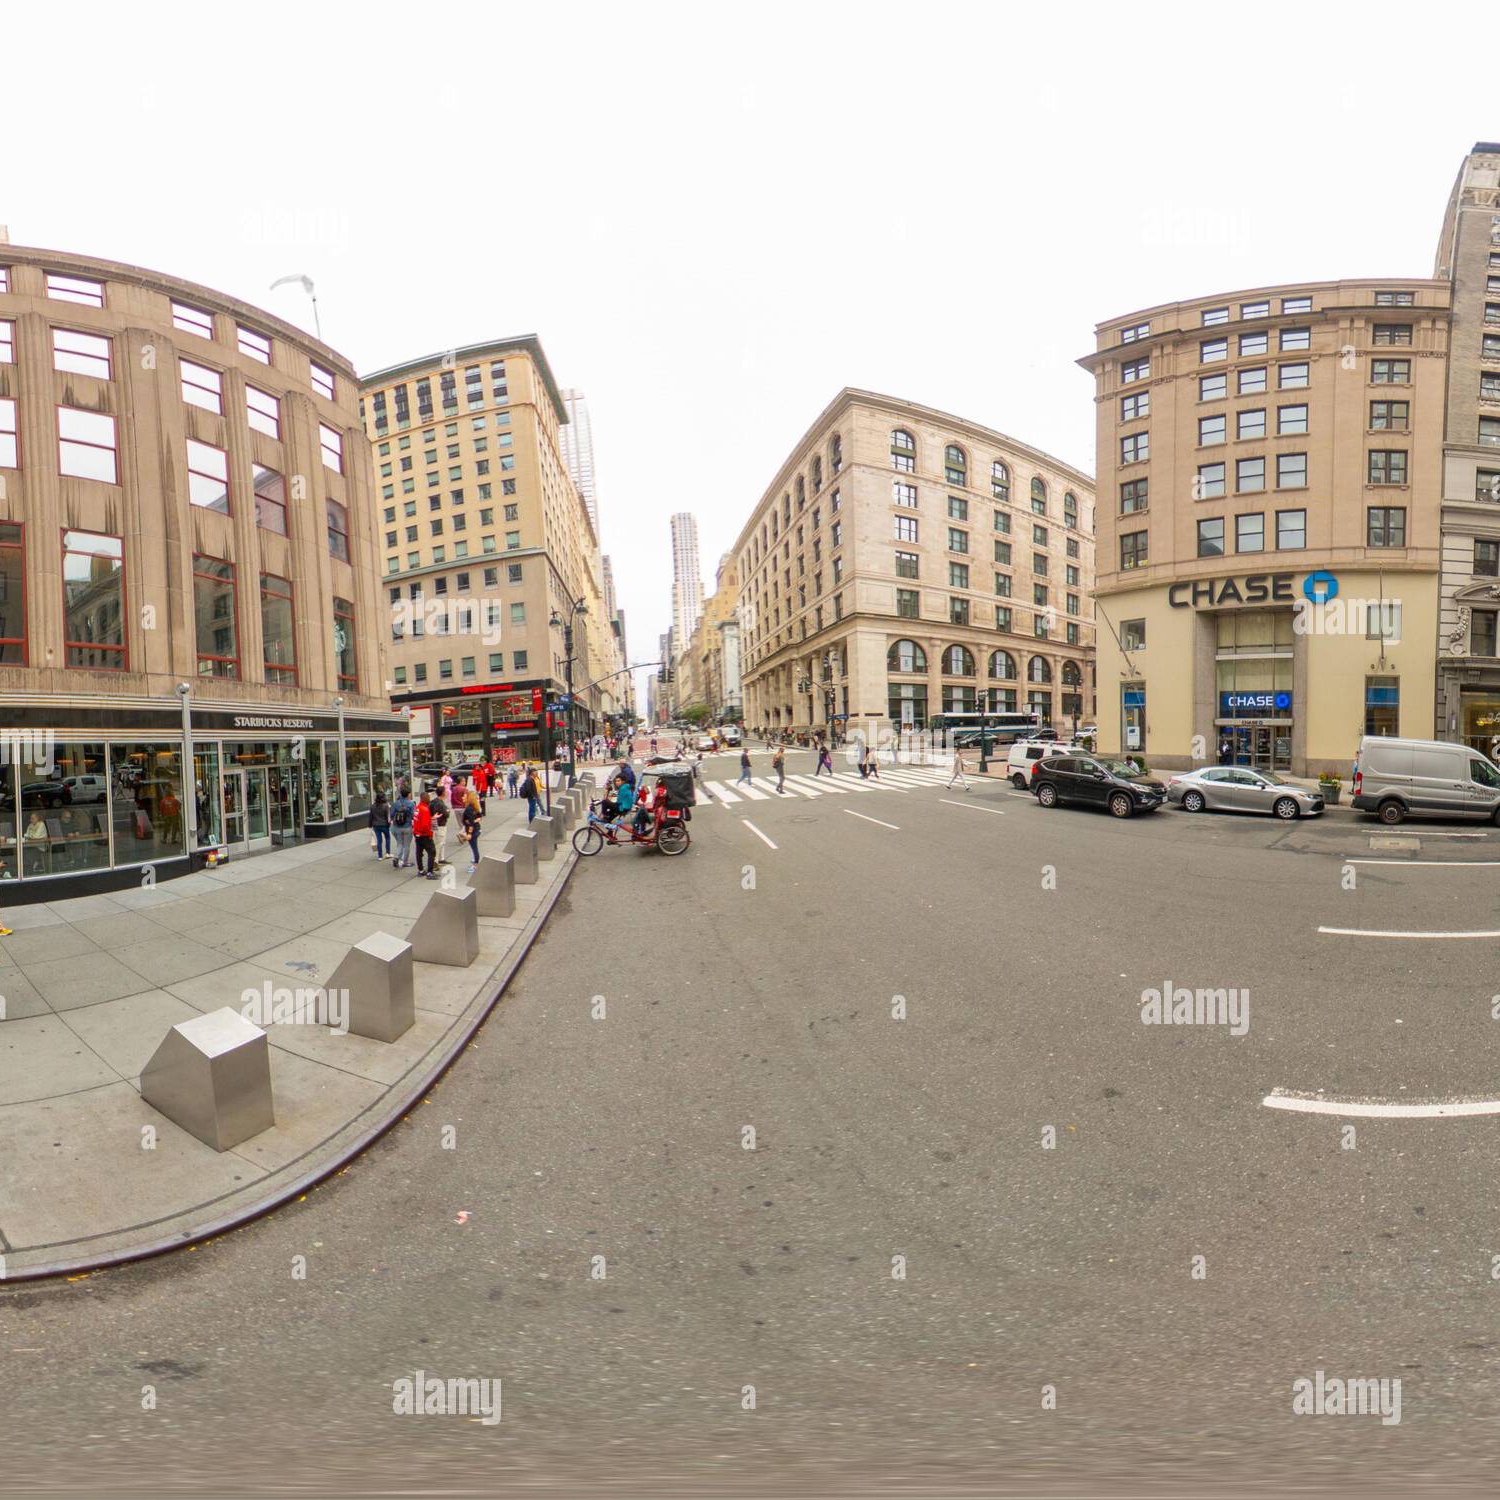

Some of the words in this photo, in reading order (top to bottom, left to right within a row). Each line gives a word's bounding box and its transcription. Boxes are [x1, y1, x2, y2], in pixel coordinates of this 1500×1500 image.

[1168, 574, 1296, 608] CHASE
[1228, 695, 1274, 707] CHASE
[234, 716, 282, 728] STARBUCKS
[283, 718, 313, 729] RESERVE
